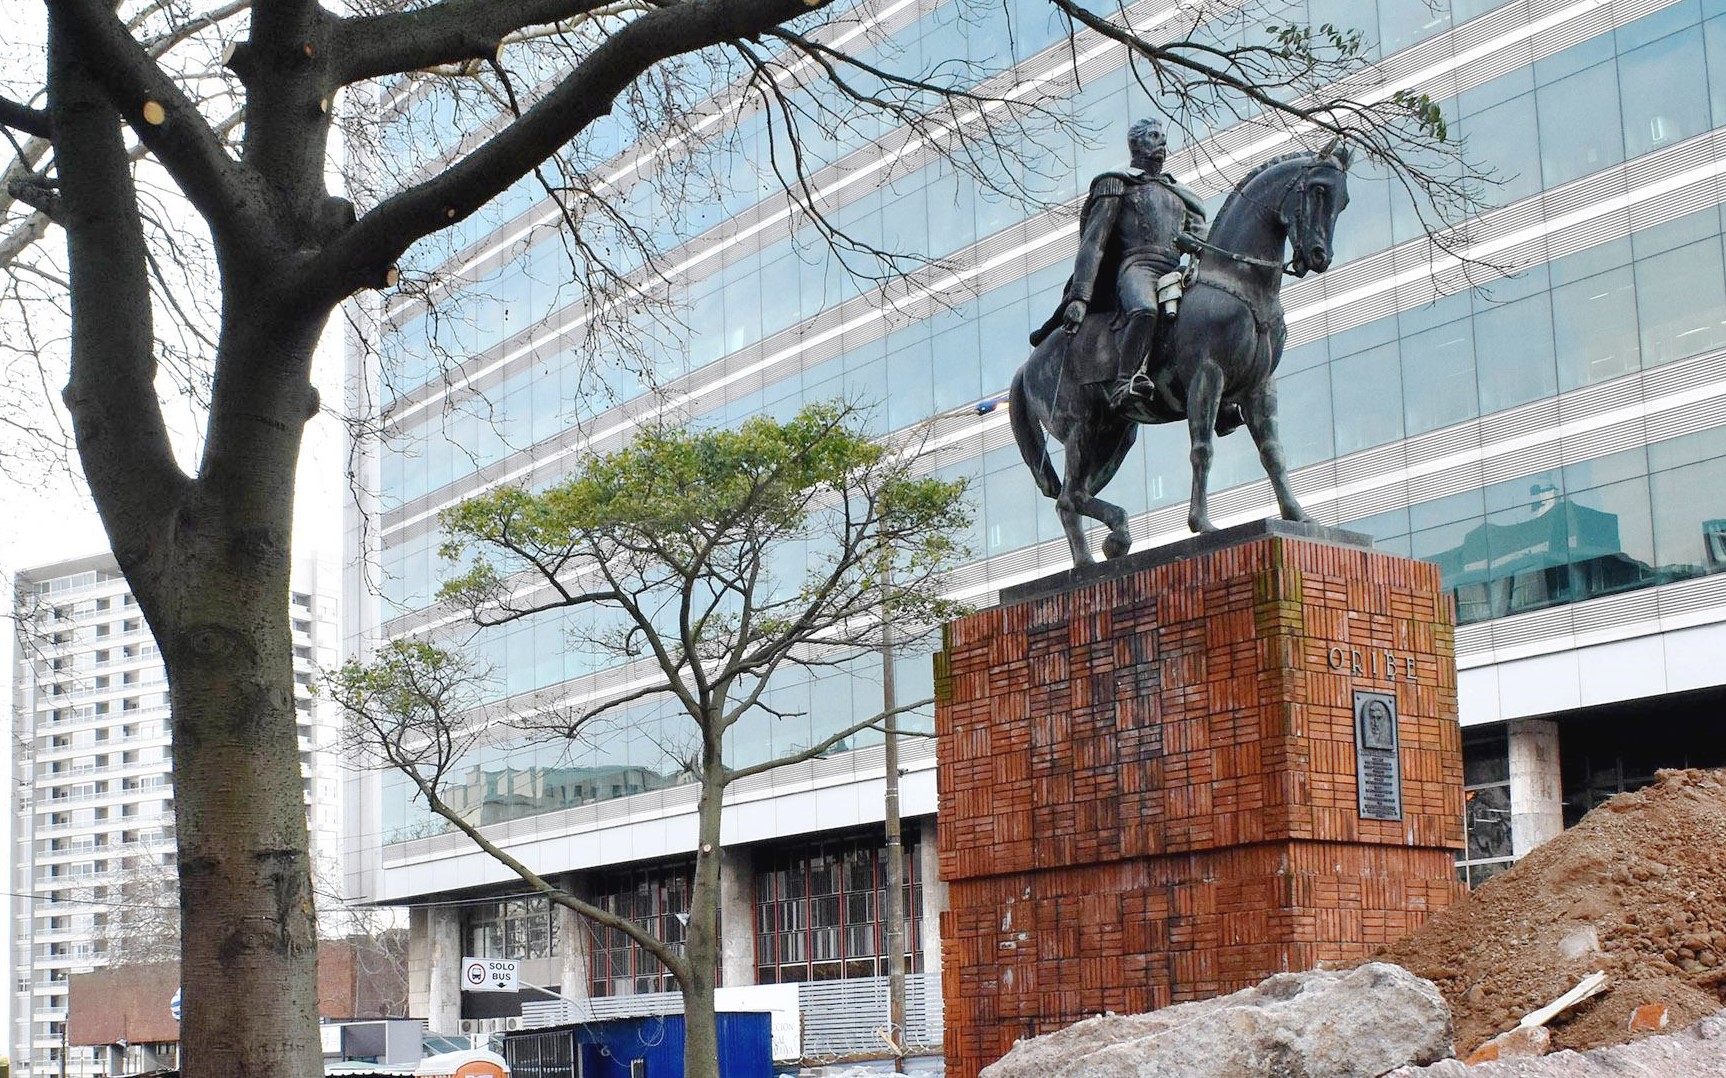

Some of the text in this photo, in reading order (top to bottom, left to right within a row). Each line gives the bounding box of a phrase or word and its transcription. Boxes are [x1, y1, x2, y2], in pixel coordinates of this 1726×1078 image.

[1329, 647, 1418, 680] ORIBE
[489, 962, 515, 971] SOLO
[492, 972, 511, 981] BUS
